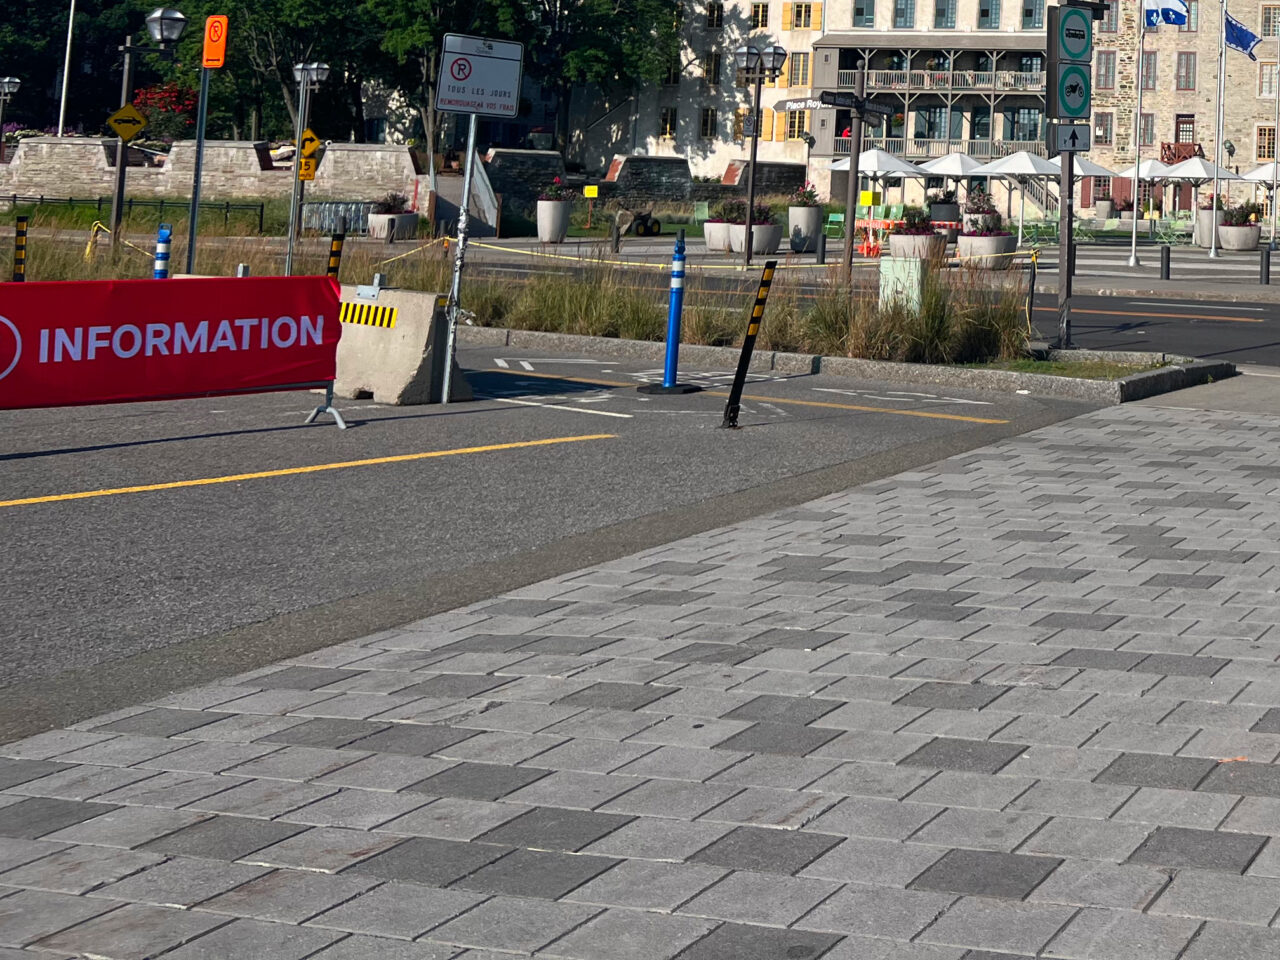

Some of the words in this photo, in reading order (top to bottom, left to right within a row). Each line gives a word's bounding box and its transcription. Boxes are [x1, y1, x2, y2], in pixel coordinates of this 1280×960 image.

[447, 84, 466, 94] TOUS
[471, 87, 485, 96] LES
[489, 89, 511, 99] JOURS
[786, 101, 805, 110] Place
[300, 161, 310, 171] 15
[39, 315, 324, 363] INFORMATION
